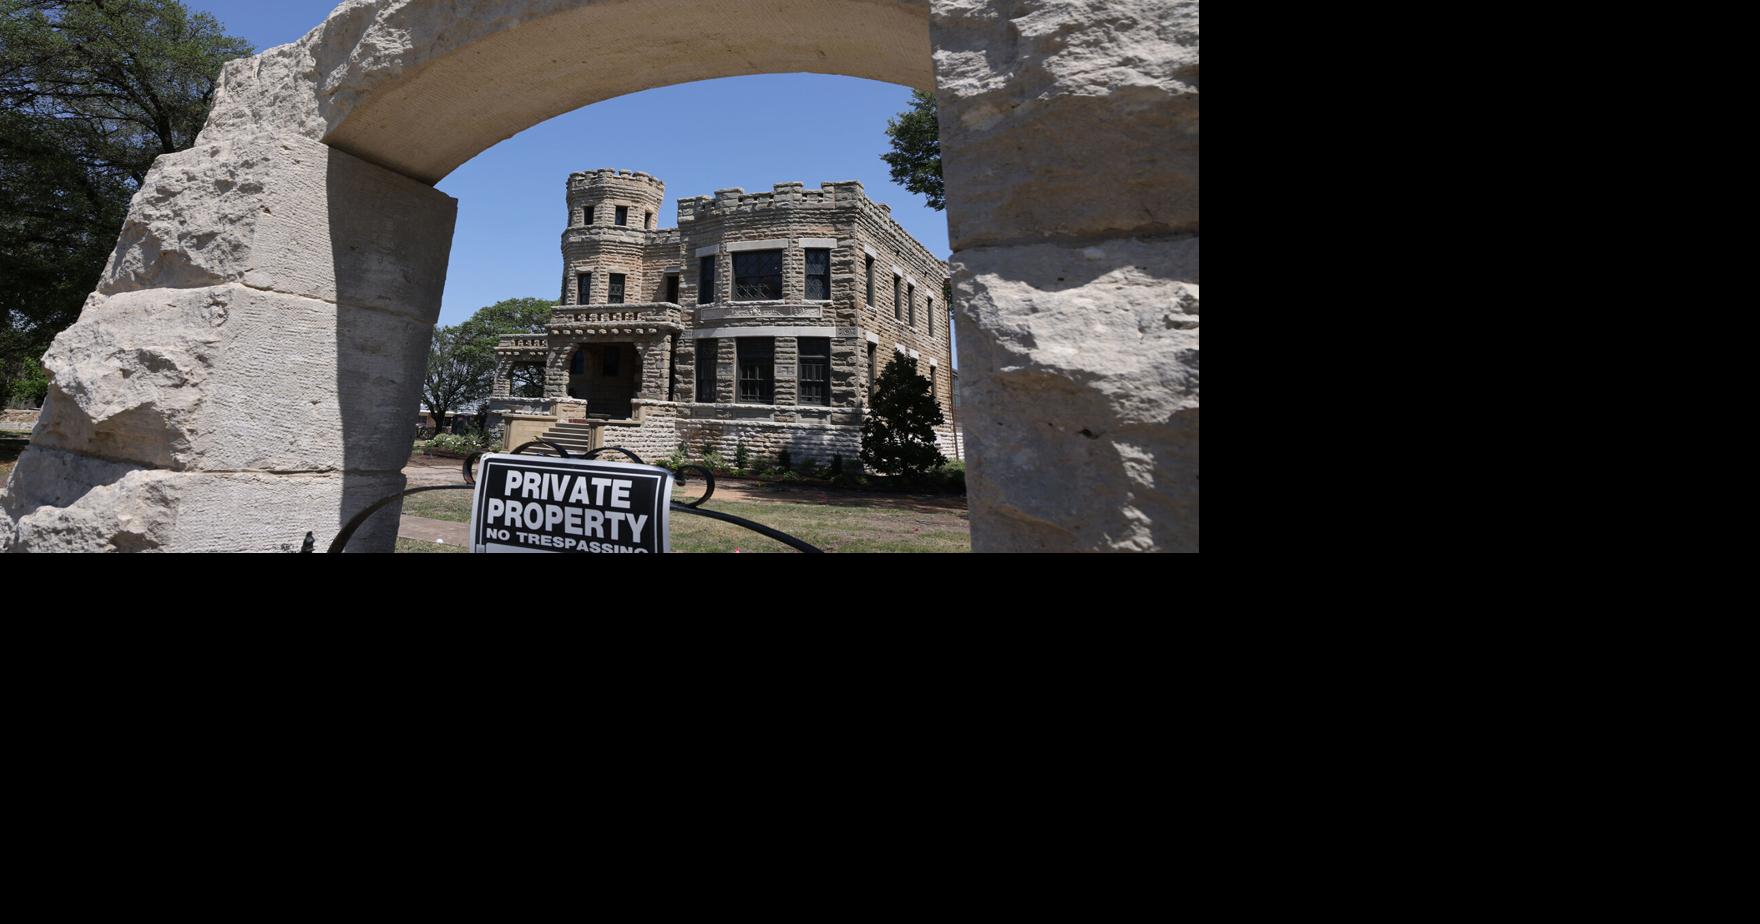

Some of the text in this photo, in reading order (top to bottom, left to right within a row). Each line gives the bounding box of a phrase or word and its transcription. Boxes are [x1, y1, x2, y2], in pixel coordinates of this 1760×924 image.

[505, 470, 633, 509] PRIVATE
[486, 528, 511, 541] NO
[487, 498, 649, 544] PROPERTY
